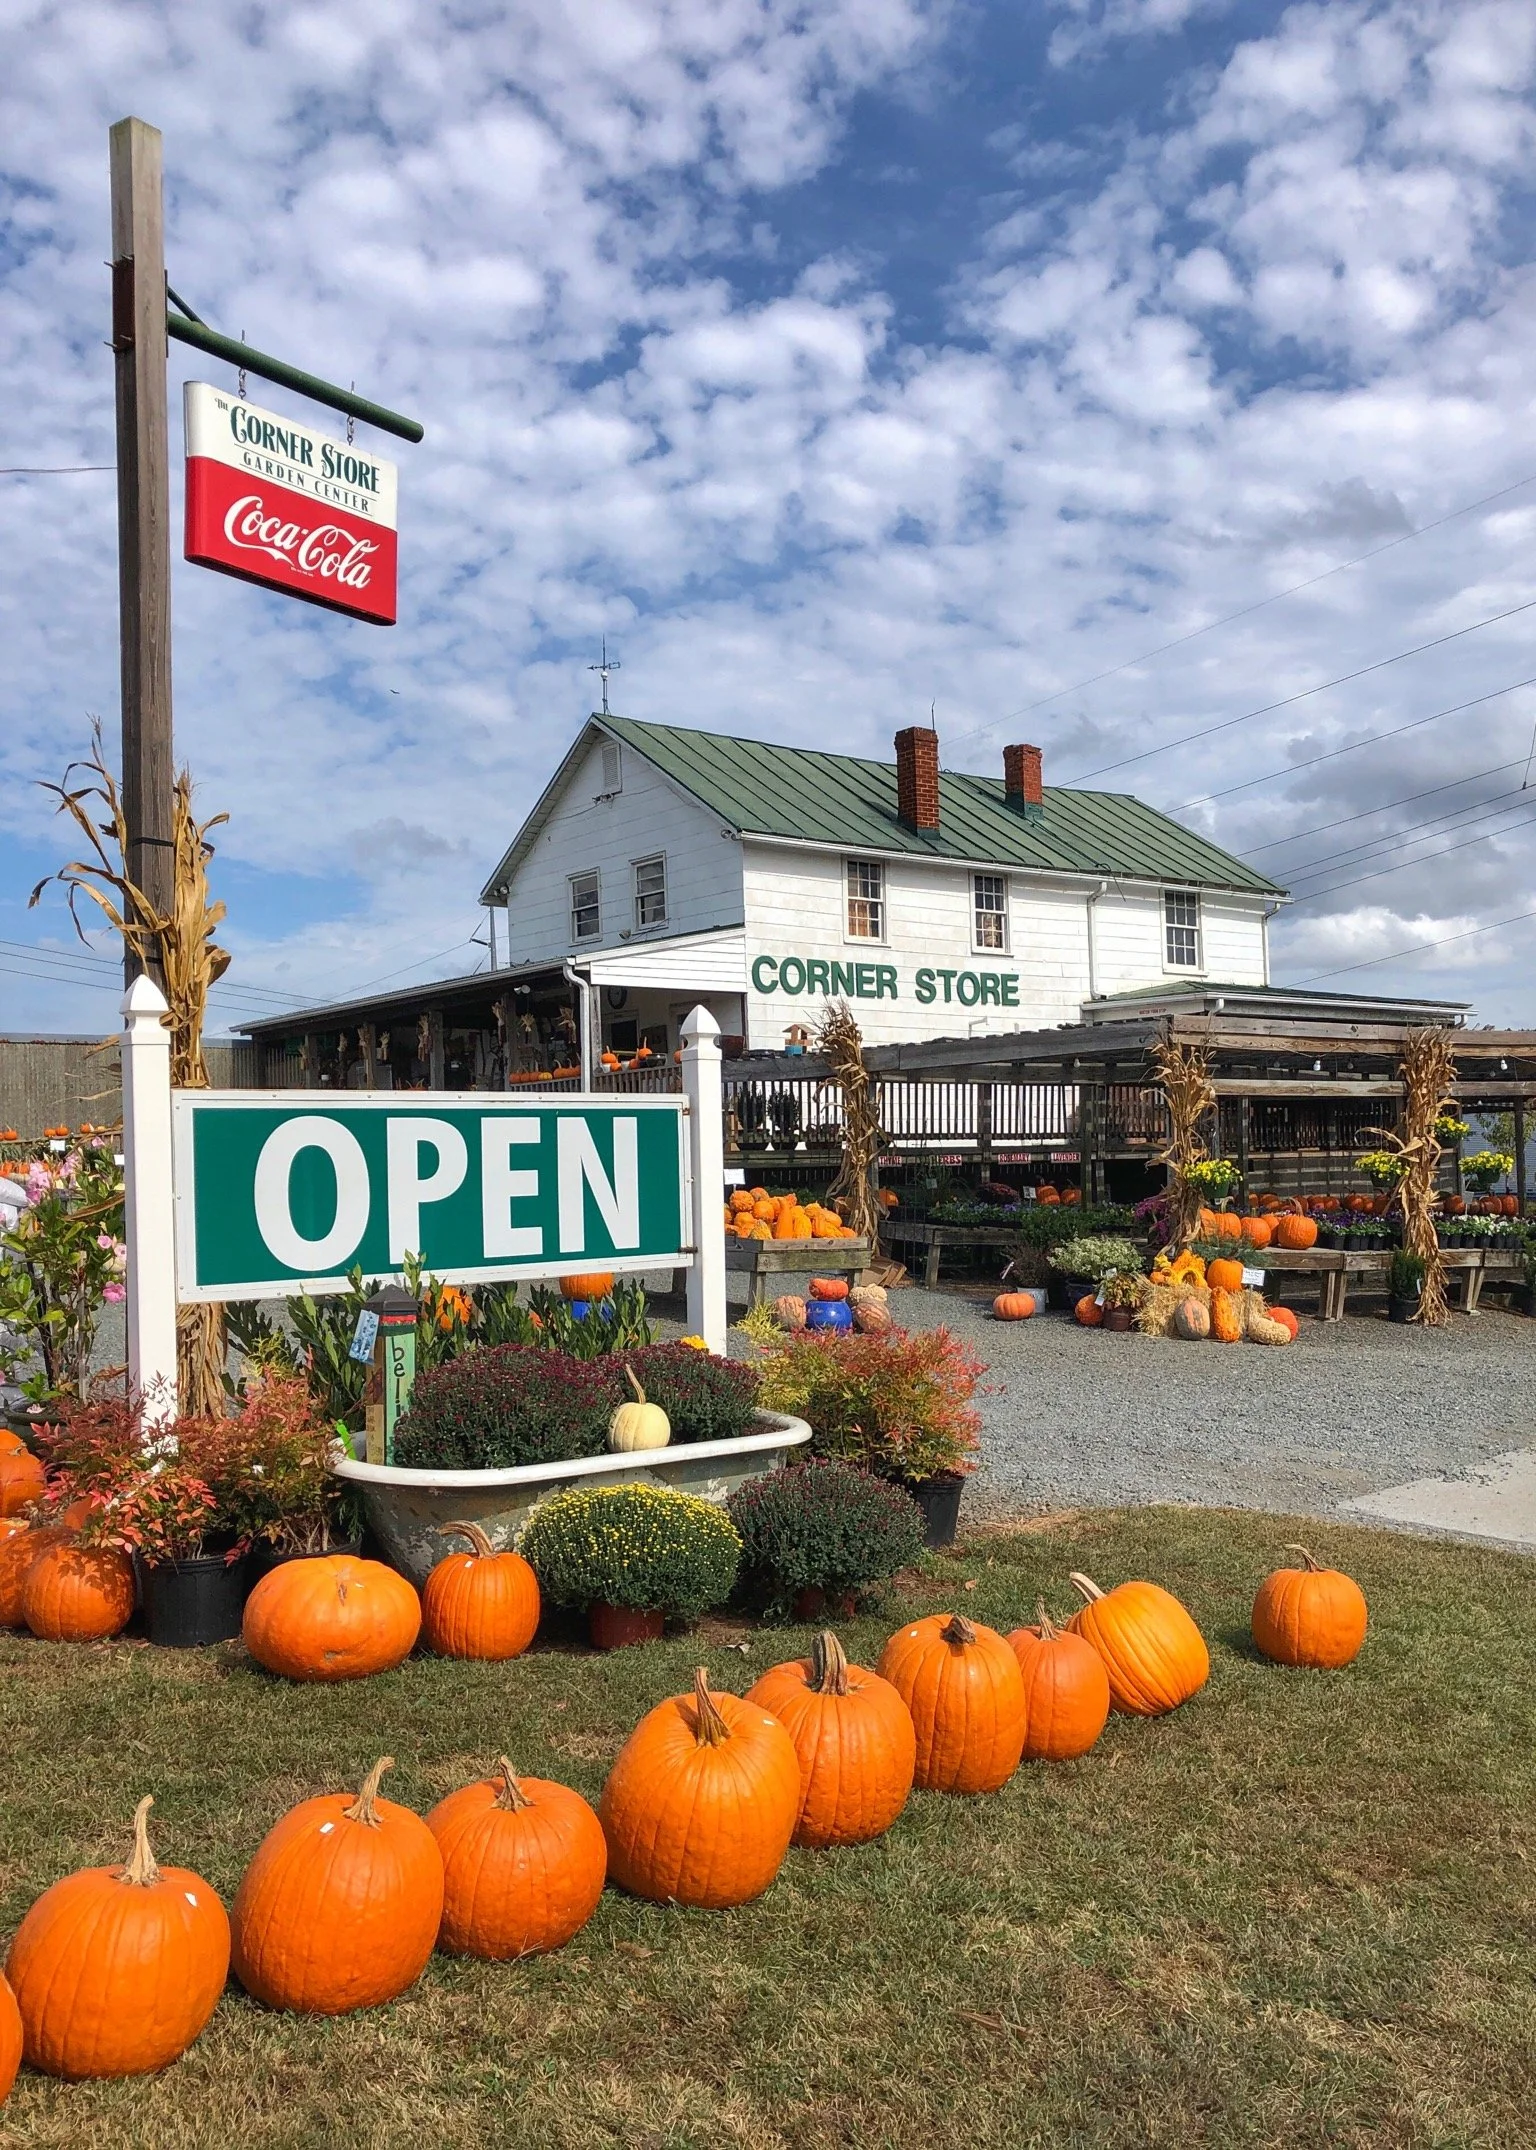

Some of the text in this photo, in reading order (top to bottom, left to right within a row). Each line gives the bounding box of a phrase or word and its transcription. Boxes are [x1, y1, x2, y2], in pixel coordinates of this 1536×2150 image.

[230, 405, 313, 468] CORNER
[321, 442, 380, 494] STORE
[243, 451, 369, 513] GARDEN CENTER
[223, 495, 381, 590] Coca-Cola
[751, 955, 1021, 1007] CORNER STORE
[254, 1115, 640, 1272] OPEN
[1000, 1153, 1030, 1163] ROSEMARY
